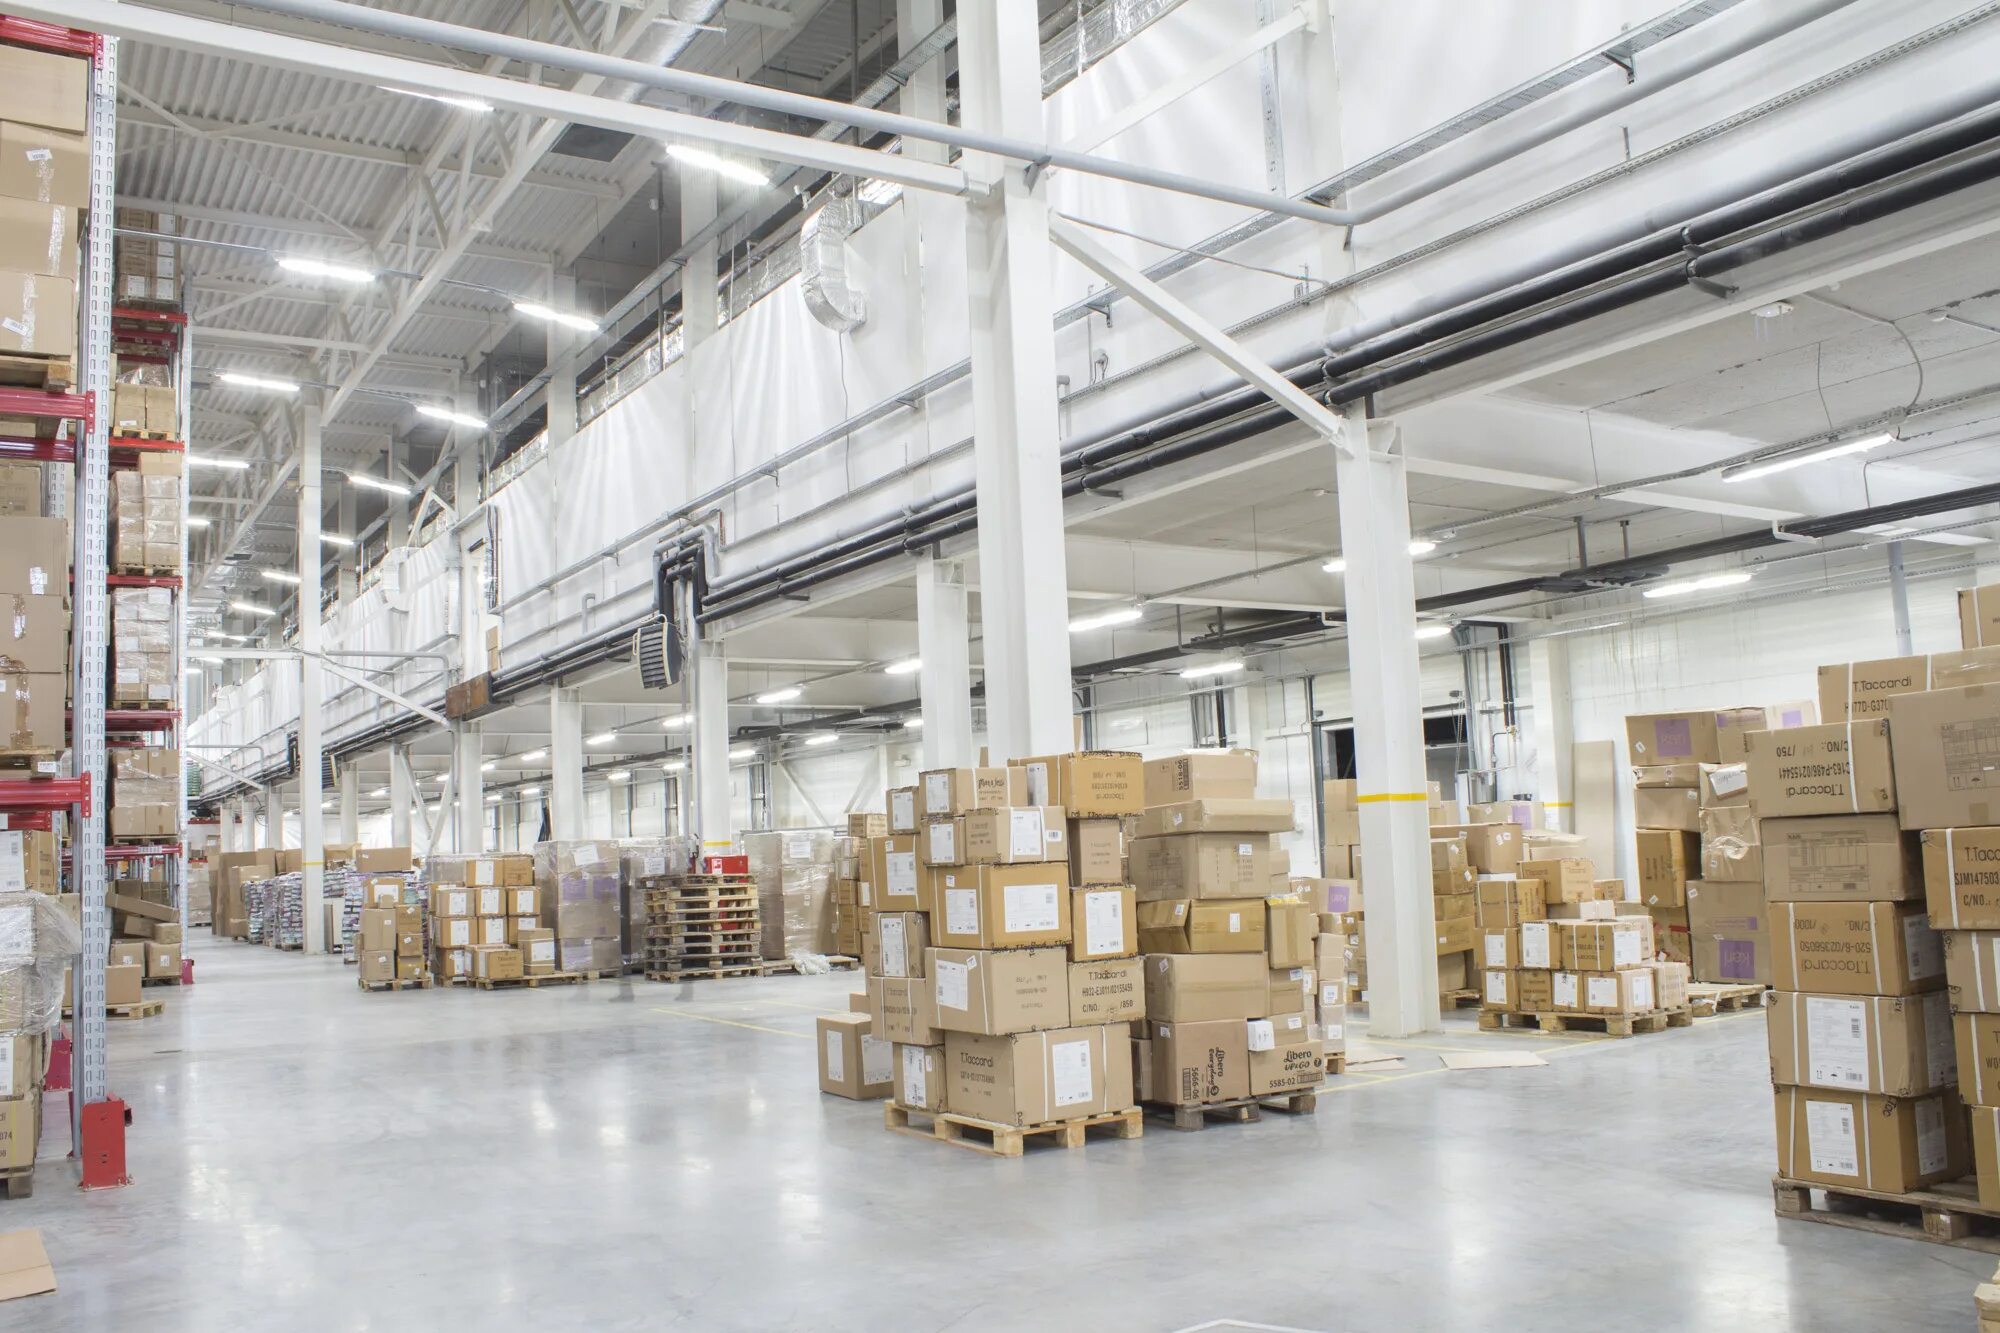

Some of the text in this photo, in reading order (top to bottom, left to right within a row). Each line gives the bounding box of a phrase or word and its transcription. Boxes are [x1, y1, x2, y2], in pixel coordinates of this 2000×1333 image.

[1852, 676, 1912, 692] T.Taccardi
[1785, 783, 1845, 798] T.Taccardi
[1215, 1047, 1226, 1077] Libero
[1283, 1050, 1312, 1063] Libero
[1191, 1067, 1199, 1099] 5666-06
[1269, 1077, 1296, 1088] 5585-02
